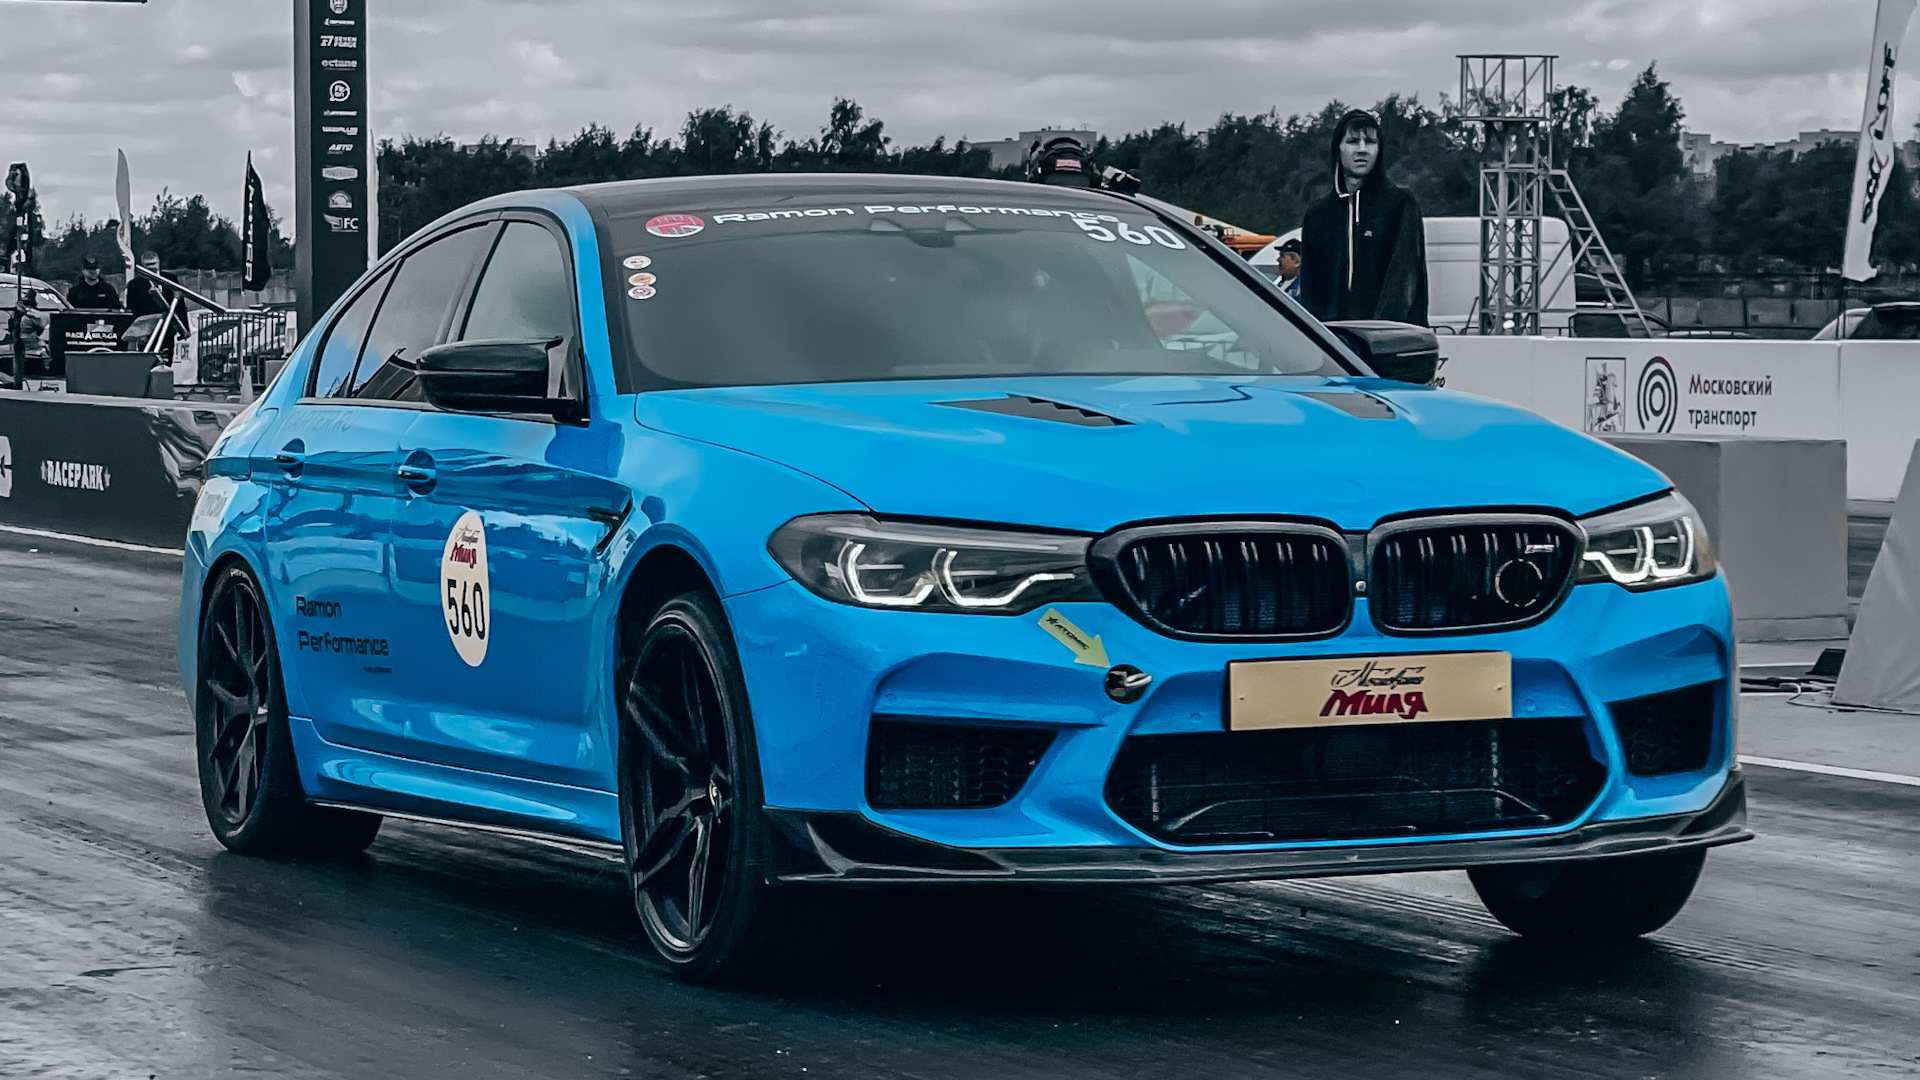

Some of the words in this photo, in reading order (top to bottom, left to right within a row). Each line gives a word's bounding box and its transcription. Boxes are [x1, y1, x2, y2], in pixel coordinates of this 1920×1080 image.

[712, 207, 855, 225] Ramon
[863, 204, 1119, 223] Performance
[1070, 217, 1187, 250] 560
[1688, 373, 1772, 396] Московский
[1688, 409, 1757, 431] транспорт
[47, 460, 104, 491] RACEPARK
[296, 595, 342, 618] Ramon
[447, 578, 485, 640] 560
[297, 629, 389, 656] Performance
[1319, 689, 1429, 720] Миля
